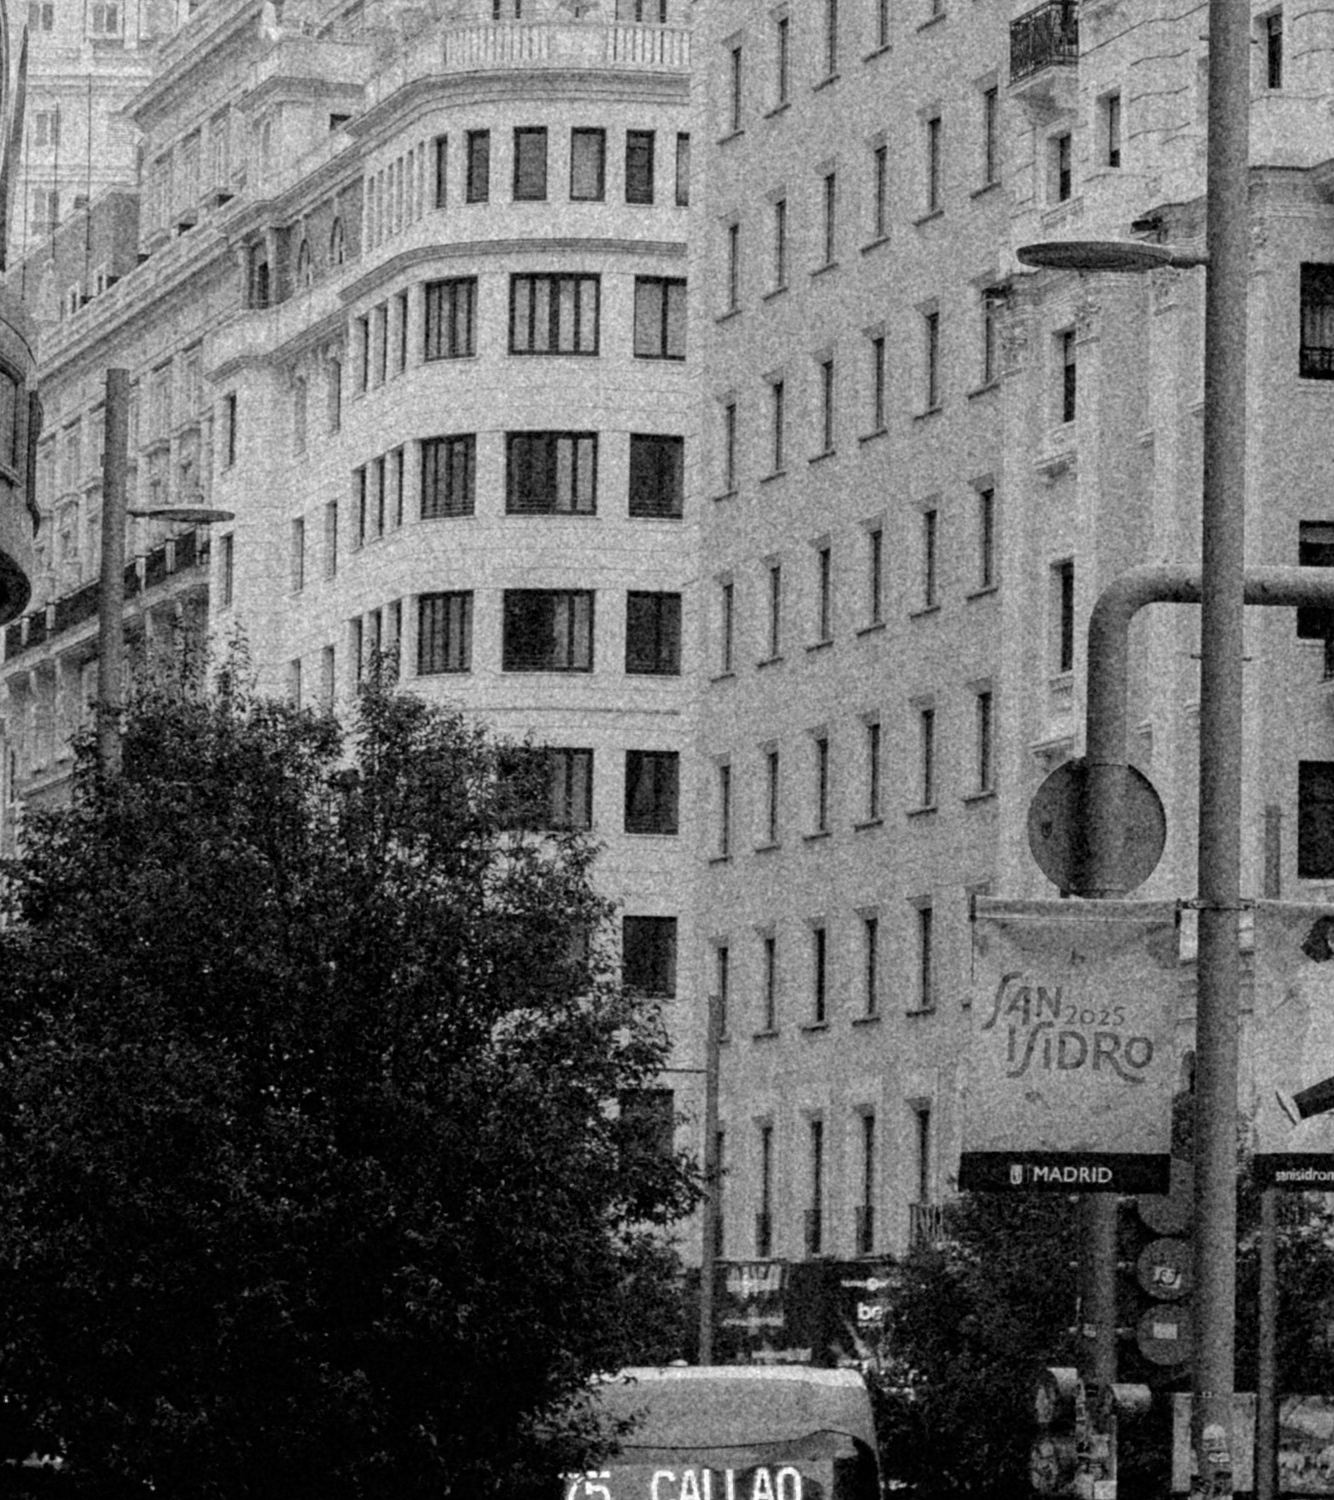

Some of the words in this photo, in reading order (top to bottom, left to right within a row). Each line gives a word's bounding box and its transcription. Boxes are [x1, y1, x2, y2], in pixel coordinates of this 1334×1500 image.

[981, 971, 1064, 1031] SAN
[1066, 1004, 1127, 1026] 2025
[1005, 1021, 1156, 1084] ISIDRO
[1032, 1165, 1113, 1184] MADRID
